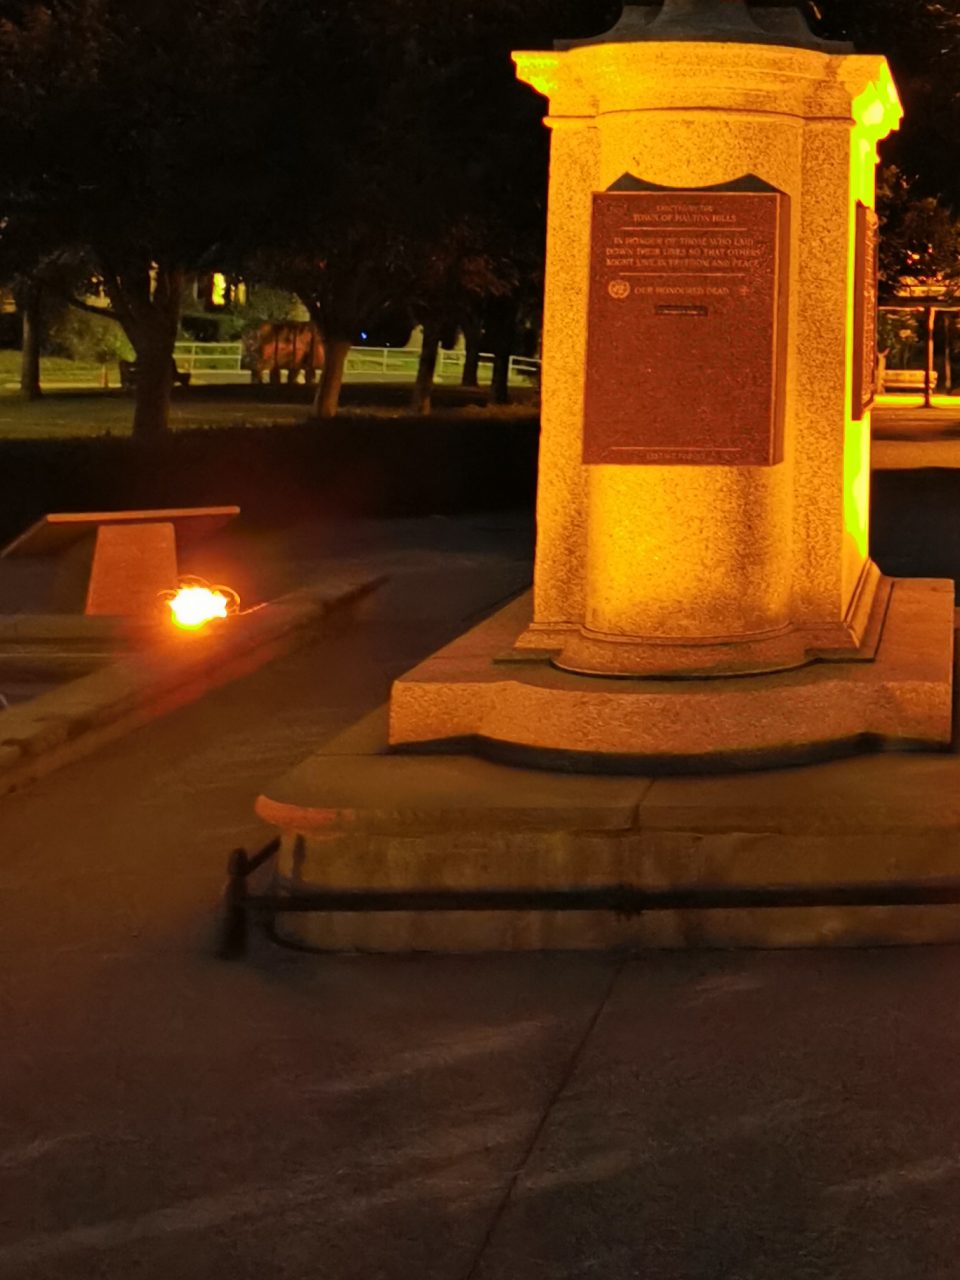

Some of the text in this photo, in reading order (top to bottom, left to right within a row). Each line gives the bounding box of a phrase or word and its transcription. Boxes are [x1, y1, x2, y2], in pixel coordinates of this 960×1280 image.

[712, 214, 737, 223] HILLS
[703, 248, 725, 256] THAT
[706, 286, 729, 295] DEAD
